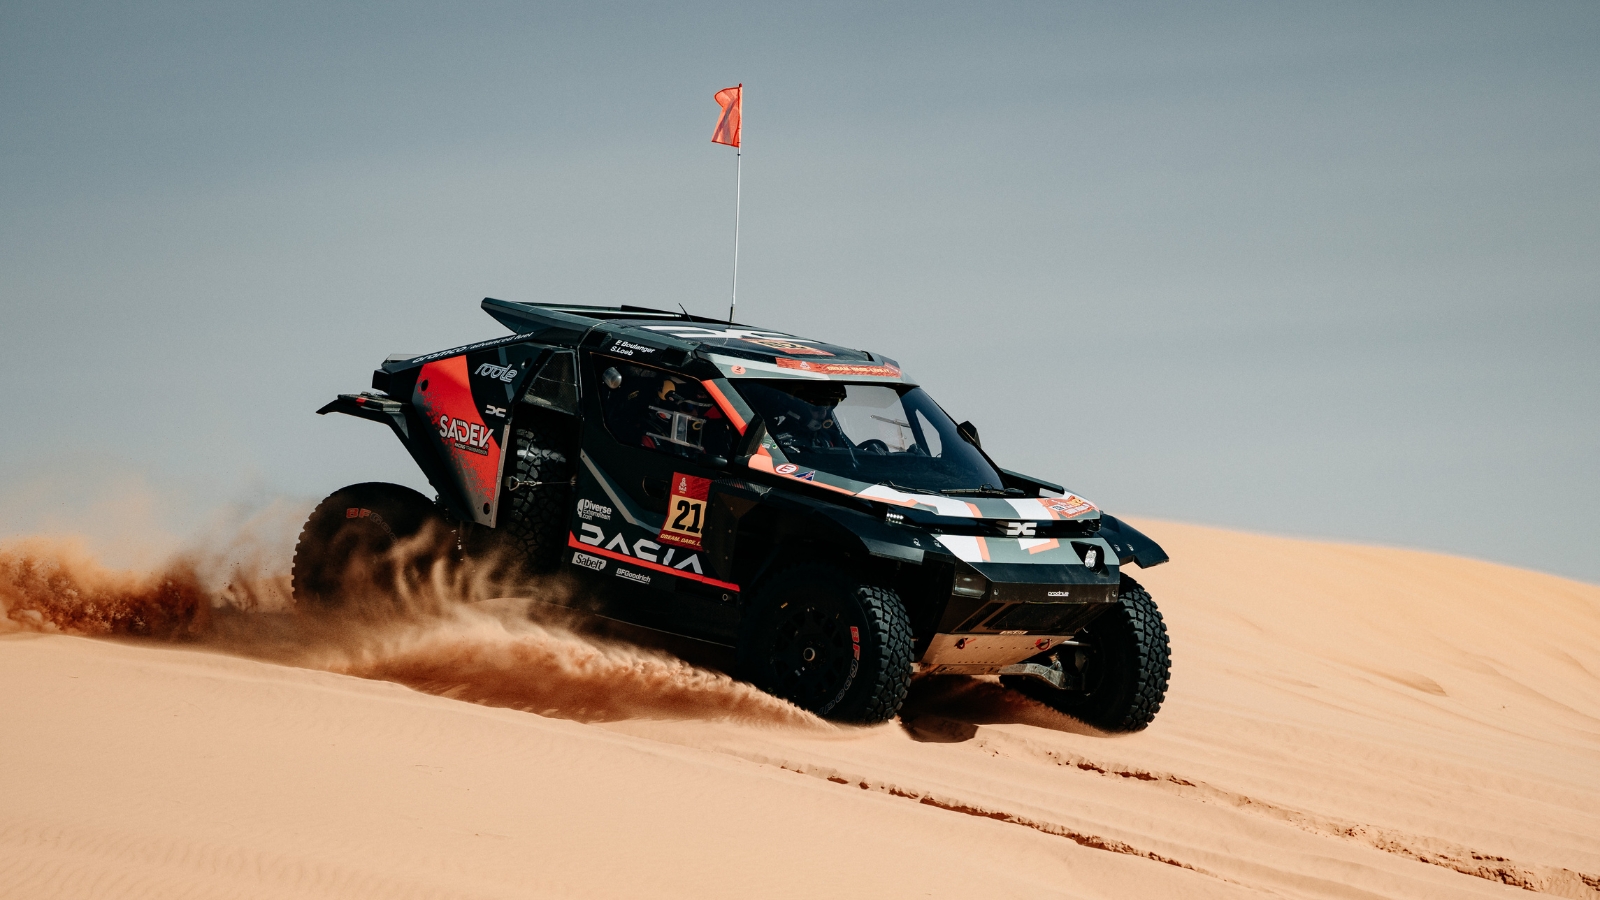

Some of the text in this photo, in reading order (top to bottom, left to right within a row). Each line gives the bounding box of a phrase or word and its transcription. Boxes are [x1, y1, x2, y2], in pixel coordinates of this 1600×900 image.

[610, 345, 634, 356] S.Loeb
[621, 341, 656, 353] Boulanger
[440, 415, 494, 448] SADEV
[584, 499, 612, 515] Diverse
[671, 500, 701, 534] 21
[579, 522, 704, 575] DACIA
[576, 553, 603, 570] Sabelt
[616, 567, 651, 583] BFGoodrich
